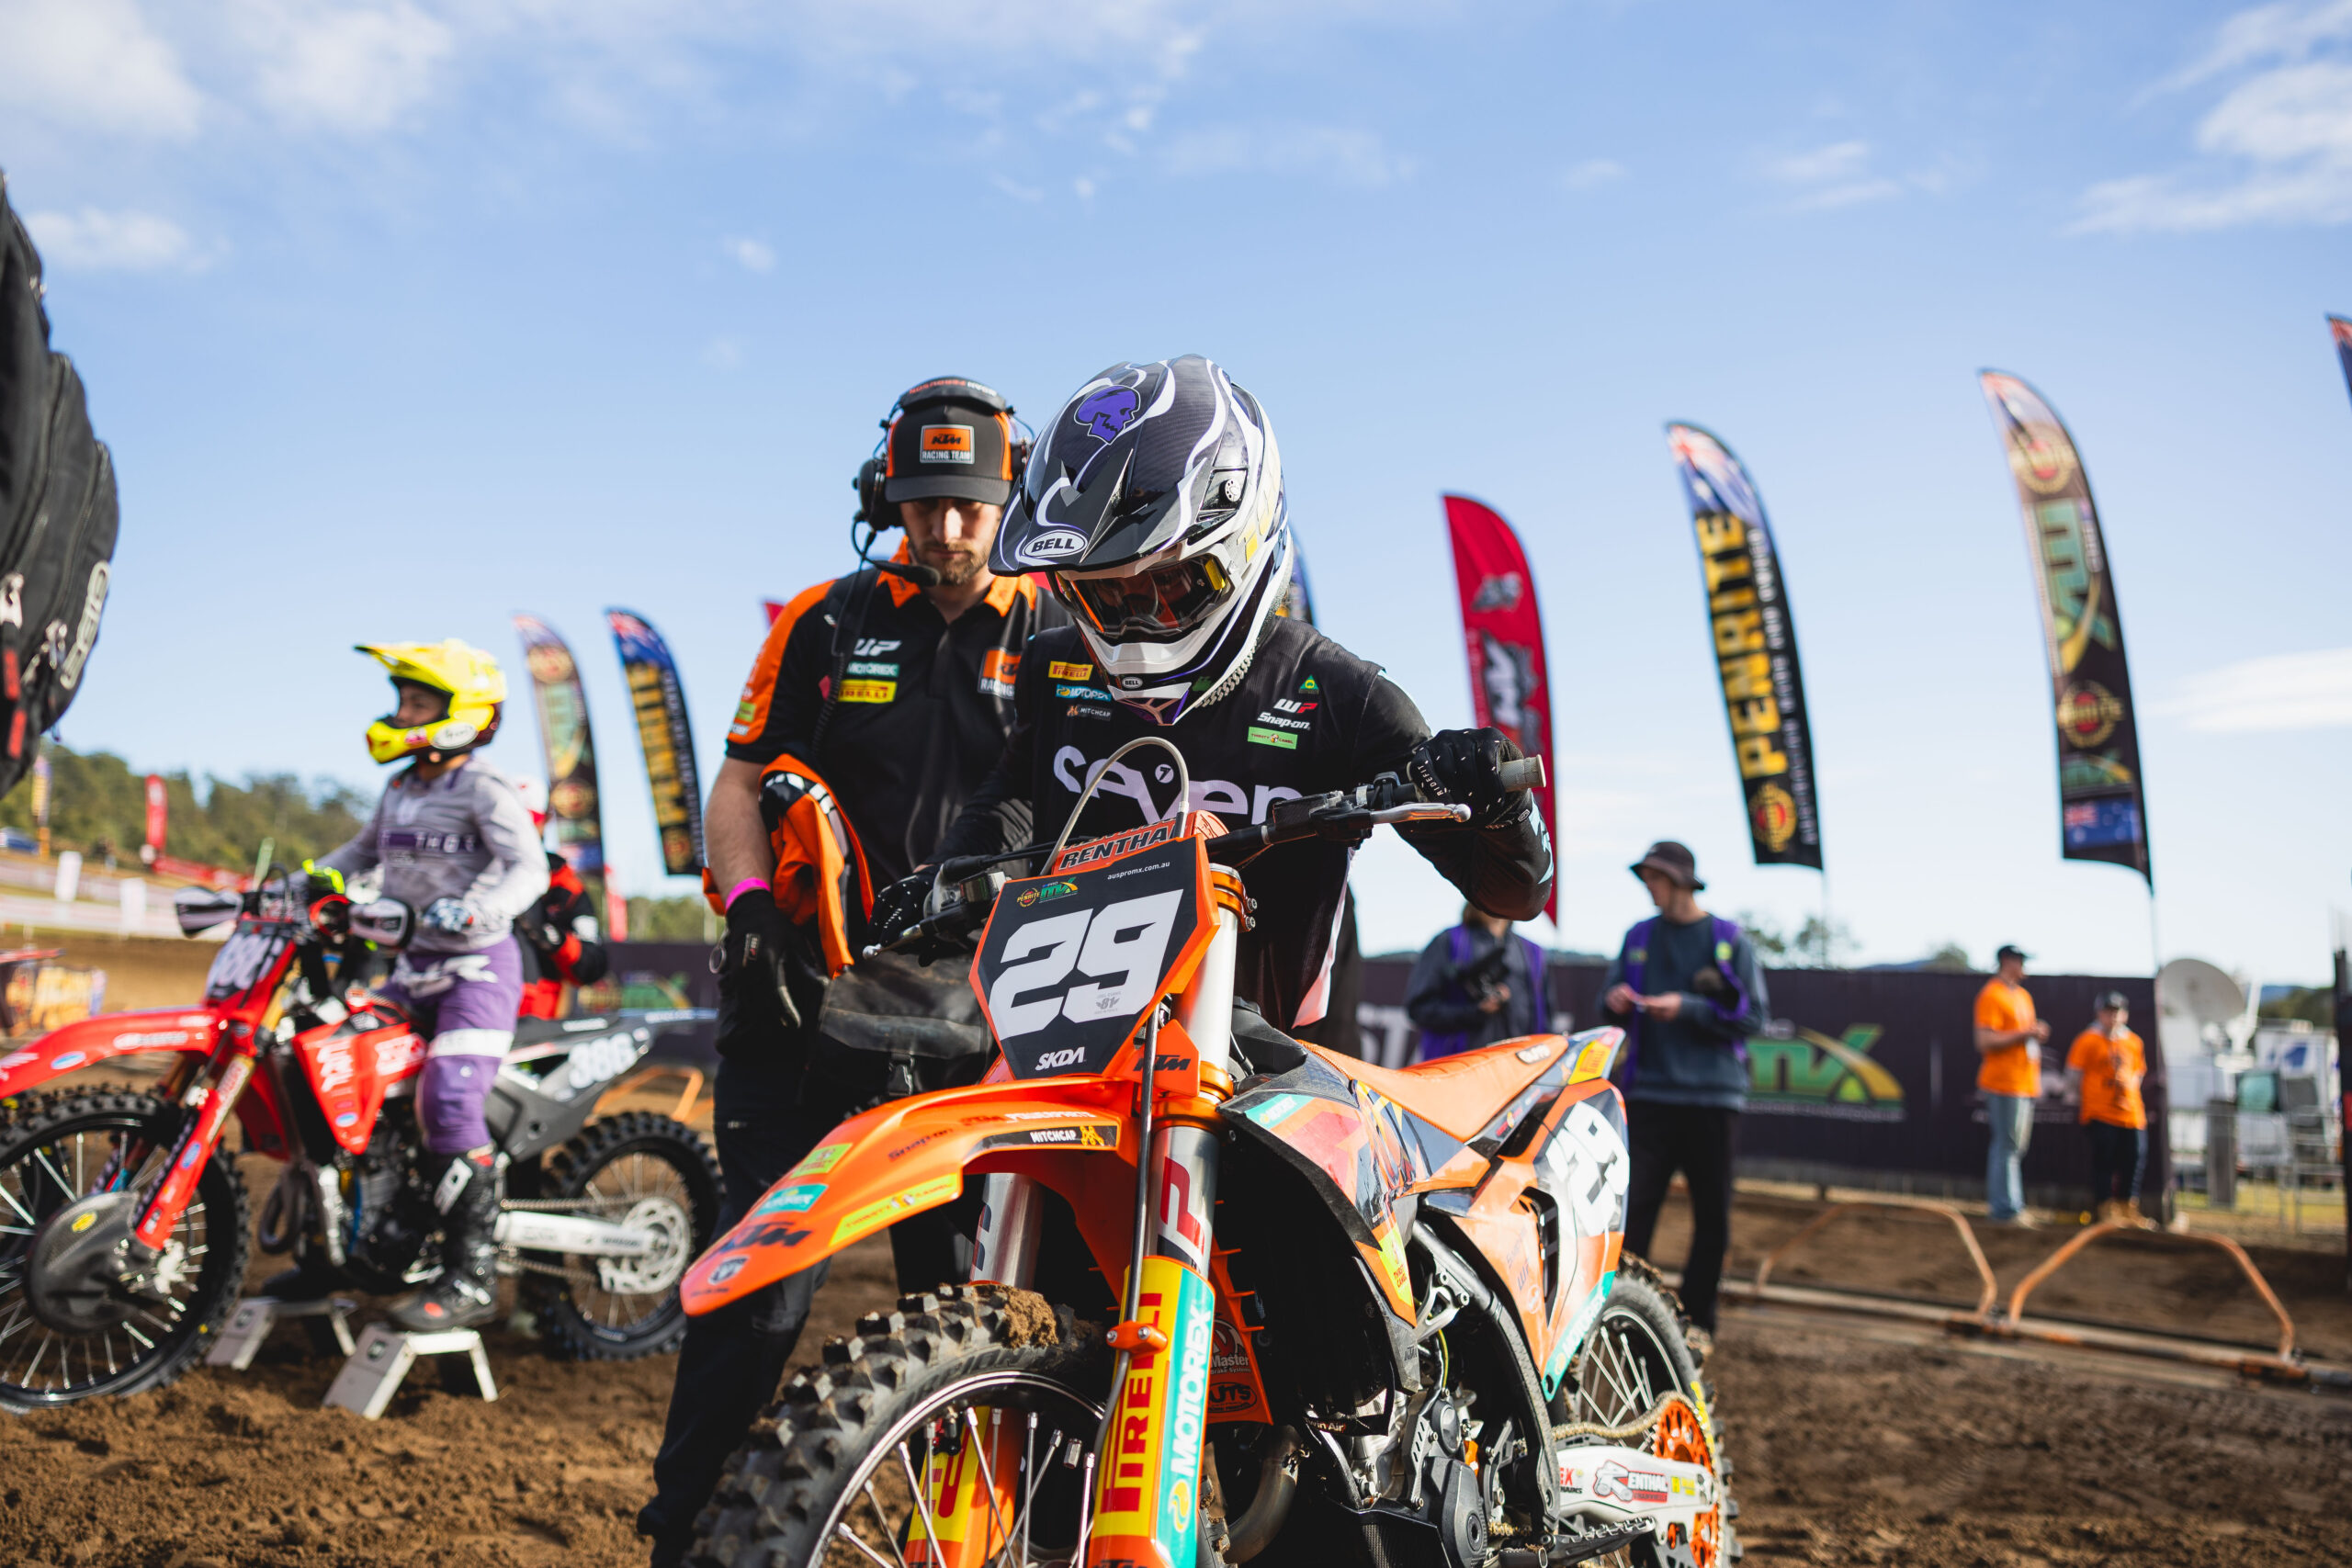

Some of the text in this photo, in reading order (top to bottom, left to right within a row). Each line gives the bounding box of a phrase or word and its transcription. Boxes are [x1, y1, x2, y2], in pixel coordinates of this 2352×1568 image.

[931, 434, 962, 446] KTM
[922, 450, 971, 460] RACING TEAM
[1031, 537, 1075, 553] BELL
[1746, 526, 1778, 604] OWNED
[1761, 604, 1786, 650] AND
[1695, 511, 1789, 780] PENRITE
[1052, 664, 1089, 678] PIRELLI
[1079, 706, 1112, 717] MITCHCAP
[1273, 698, 1318, 714] WP
[1257, 711, 1311, 730] Snap-on
[1158, 766, 1172, 782] 7
[1417, 764, 1445, 796] RIDEFIT
[1106, 860, 1171, 882] auspromx.com.au
[1016, 891, 1041, 904] PENRITE
[988, 888, 1184, 1042] 29
[1035, 1046, 1087, 1072] SKDA
[1029, 1130, 1078, 1144] MITCHCAP
[1170, 1298, 1213, 1478] MOTOREX
[1209, 1384, 1251, 1404] UTS
[1328, 1421, 1345, 1433] Air
